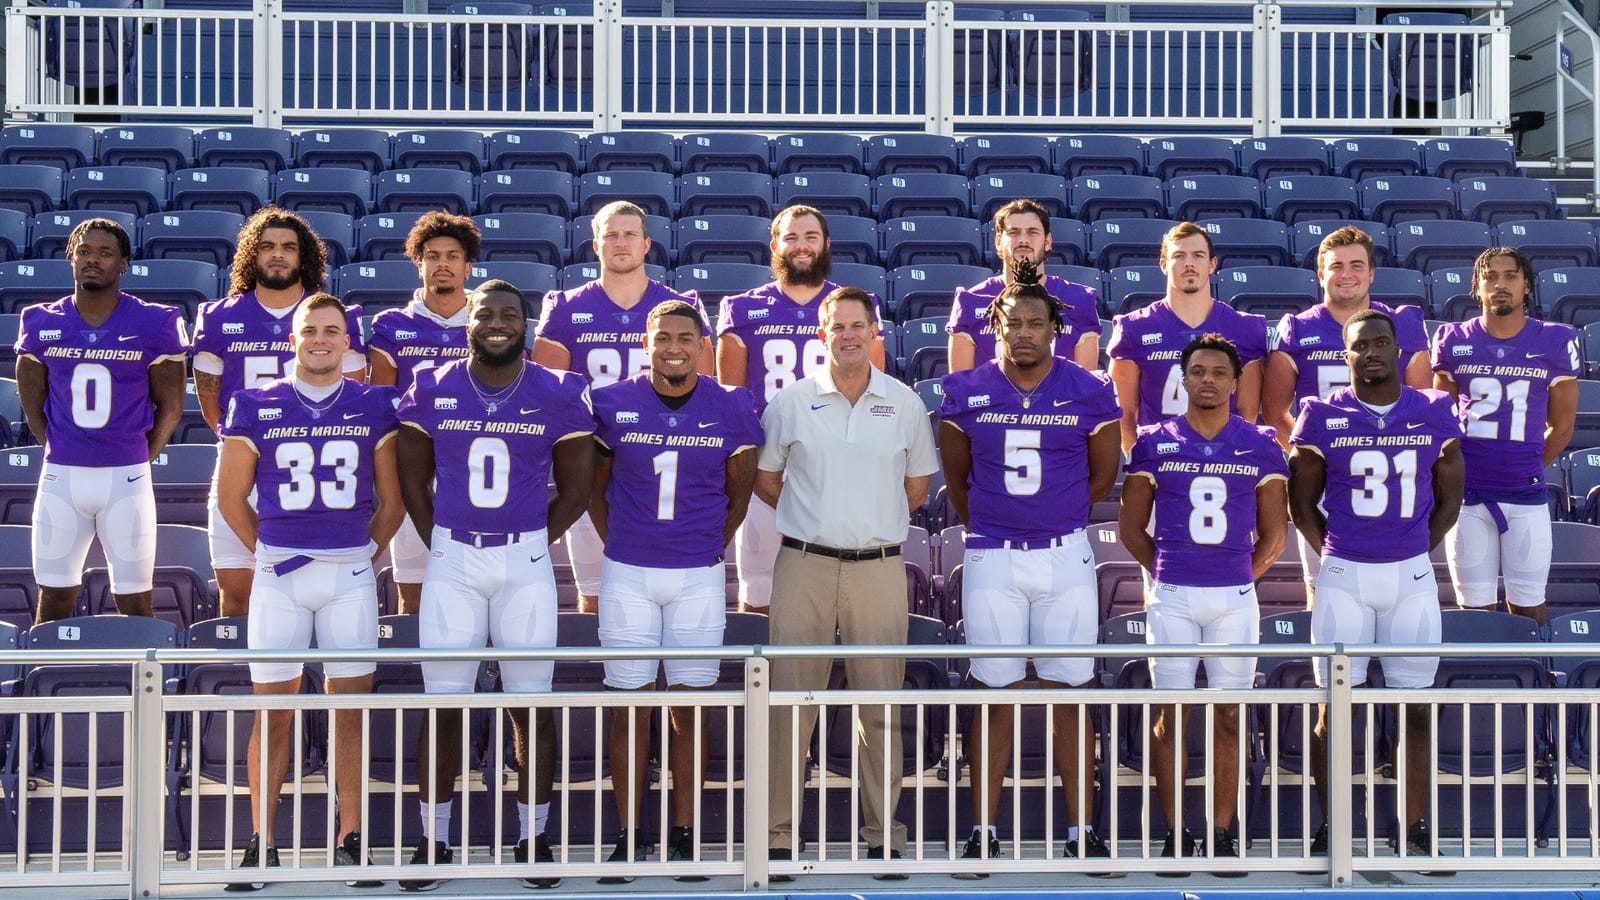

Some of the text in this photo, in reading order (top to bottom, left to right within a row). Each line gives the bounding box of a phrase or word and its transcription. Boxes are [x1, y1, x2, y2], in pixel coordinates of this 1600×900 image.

[754, 324, 794, 335] JAMES
[576, 332, 618, 343] JAMES
[43, 346, 144, 361] JAMES MADISON
[227, 341, 269, 353] JAMES
[397, 346, 439, 357] JAMES
[243, 355, 296, 390] 5
[1454, 364, 1549, 379] JAMES MADISON
[70, 362, 112, 429] 0
[1466, 376, 1531, 442] 21
[975, 412, 1079, 426] JAMES MADISON
[262, 425, 371, 440] JAMES MADISON
[437, 419, 545, 436] JAMES MADISON
[620, 432, 724, 448] JAMES MADISON
[1330, 435, 1432, 448] JAMES MADISON
[15, 454, 22, 466] 3
[1004, 429, 1042, 496] 5
[275, 440, 360, 511] 33
[467, 436, 511, 509] 0
[1157, 461, 1260, 476] JAMES MADISON
[652, 450, 679, 520] 1
[1350, 449, 1418, 518] 31
[1188, 476, 1228, 545] 8
[1103, 530, 1112, 543] 11
[65, 627, 72, 639] 4
[223, 625, 230, 639] 5
[379, 625, 386, 638] 6
[1130, 621, 1141, 634] 11
[1278, 621, 1290, 634] 12
[1574, 621, 1585, 634] 14
